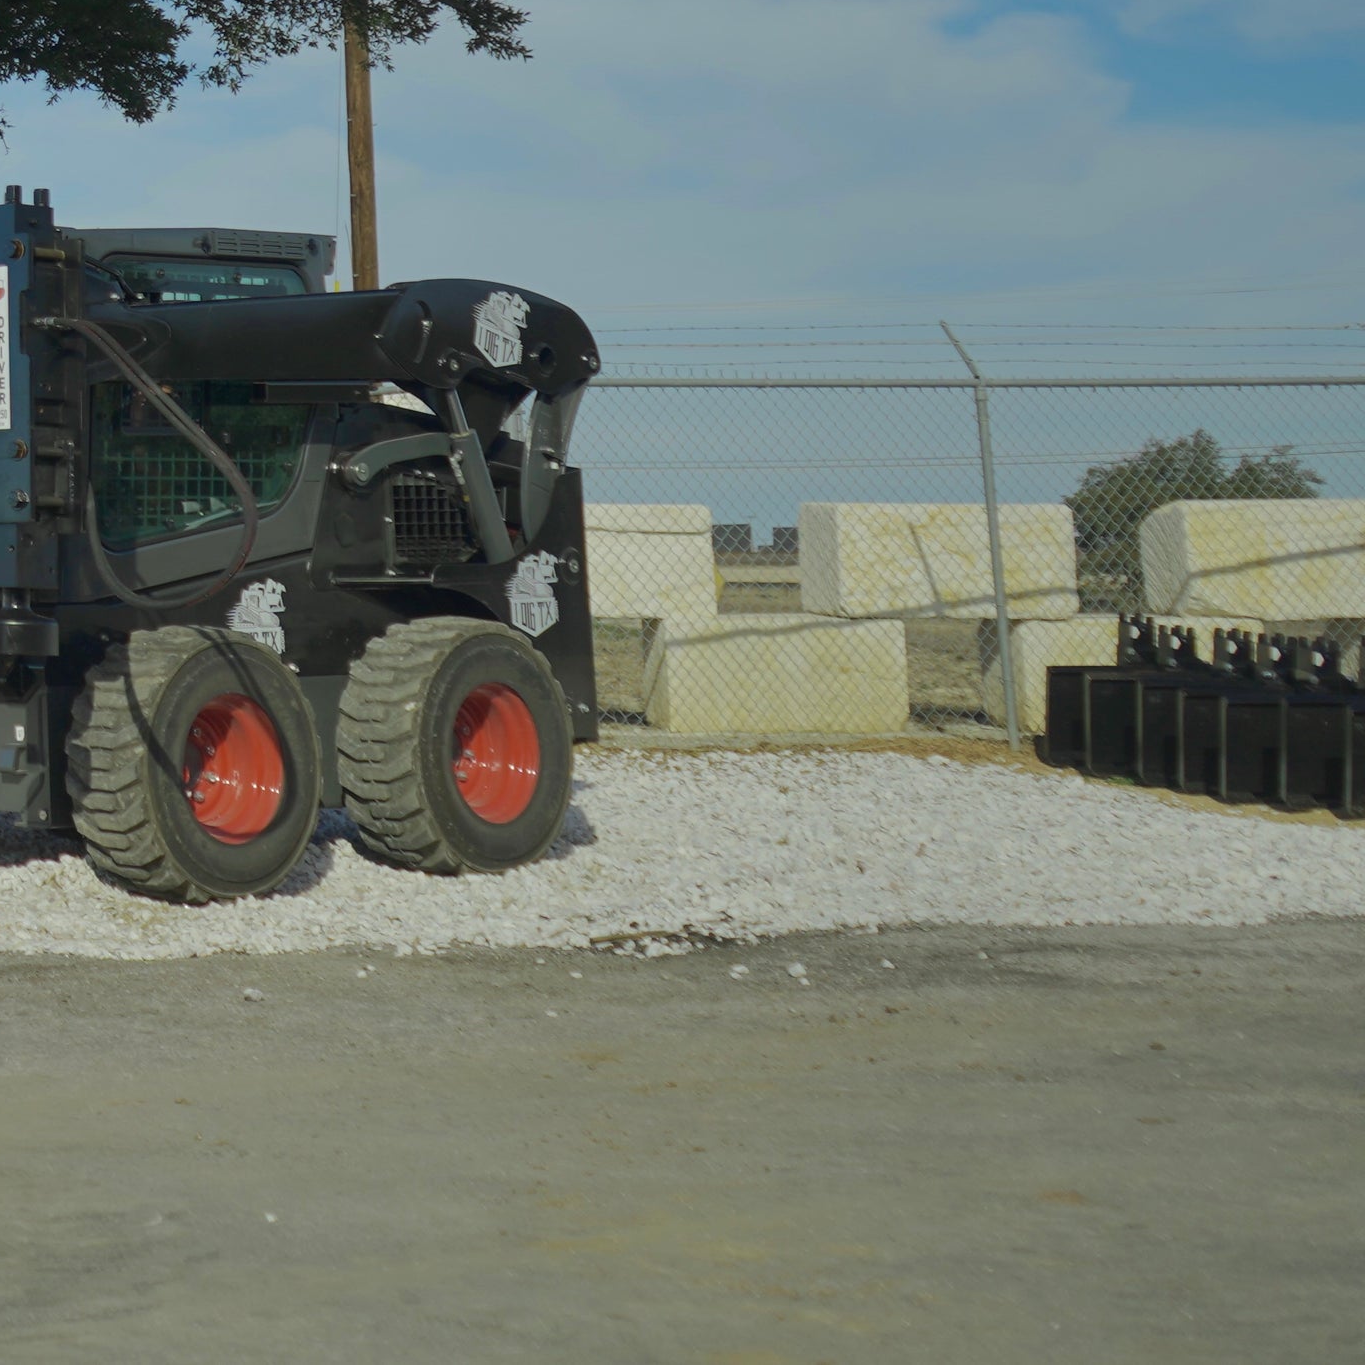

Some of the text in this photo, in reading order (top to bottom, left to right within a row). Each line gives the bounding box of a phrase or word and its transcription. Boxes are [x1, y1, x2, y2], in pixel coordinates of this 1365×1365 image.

[502, 336, 517, 363] TX
[520, 601, 536, 632] DIG
[537, 601, 554, 628] TX
